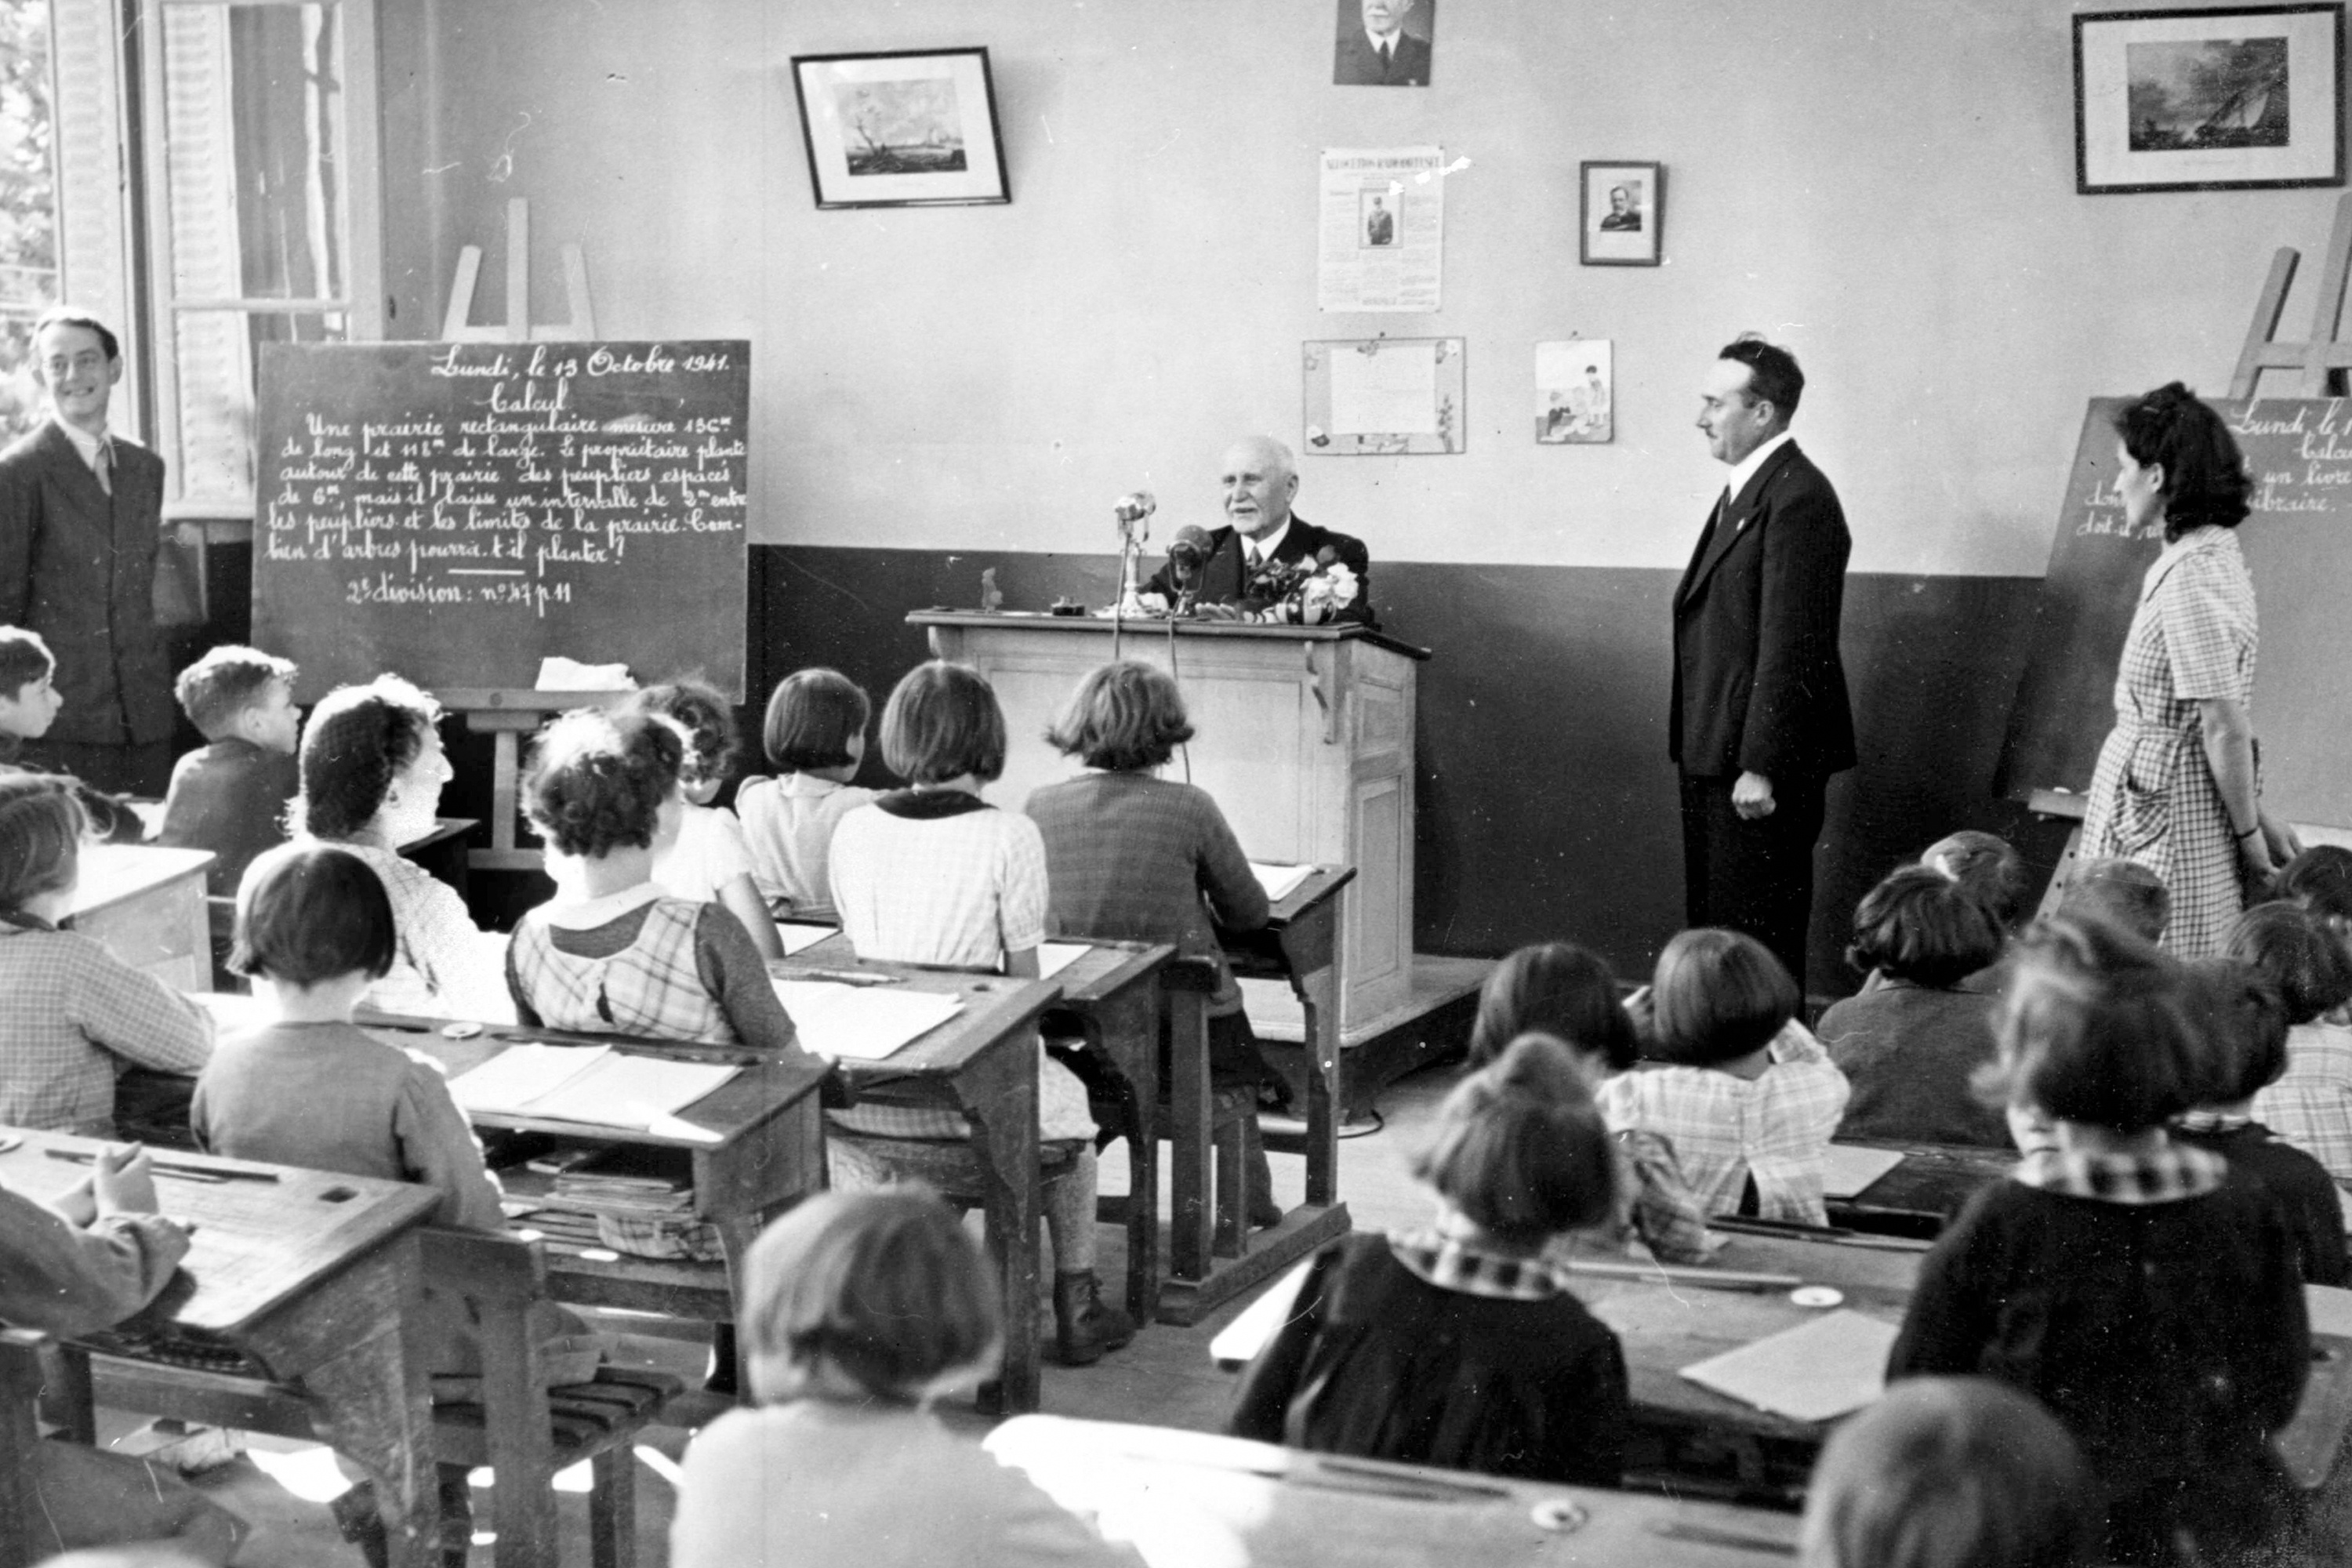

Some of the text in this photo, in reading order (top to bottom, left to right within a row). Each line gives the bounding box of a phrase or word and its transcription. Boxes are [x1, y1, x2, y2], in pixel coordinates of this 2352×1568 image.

[430, 343, 519, 380] Lundi,
[526, 345, 546, 376] le
[554, 358, 578, 377] 13
[587, 344, 675, 376] Octobre
[474, 376, 569, 413] Calcul
[306, 412, 350, 436] Une
[362, 412, 445, 455] prairie
[459, 408, 597, 450] rectangulaire
[608, 419, 676, 434] mesure
[2316, 397, 2344, 435] le
[281, 437, 303, 457] de
[309, 436, 355, 470] long
[371, 441, 391, 457] et
[452, 437, 476, 457] de
[483, 434, 545, 469] large.
[559, 434, 575, 457] Le
[582, 435, 690, 471] propriétaire
[695, 435, 746, 470] plante
[280, 459, 730, 500] autour de cette prairie des peupliers espacés
[2263, 460, 2352, 485] un livre
[278, 481, 300, 506] de
[354, 487, 401, 504] mais
[405, 481, 426, 504] il
[445, 481, 497, 504] laisse
[504, 495, 537, 508] un
[539, 484, 637, 508] intervalle
[644, 484, 669, 506] de
[710, 486, 747, 506] entre
[265, 501, 296, 530] les
[306, 503, 394, 545] peupliers
[404, 510, 424, 529] et
[429, 498, 456, 531] les
[463, 506, 531, 531] limites
[540, 509, 563, 530] de
[572, 507, 599, 532] la
[605, 508, 687, 549] prairie.
[263, 532, 307, 560] bien
